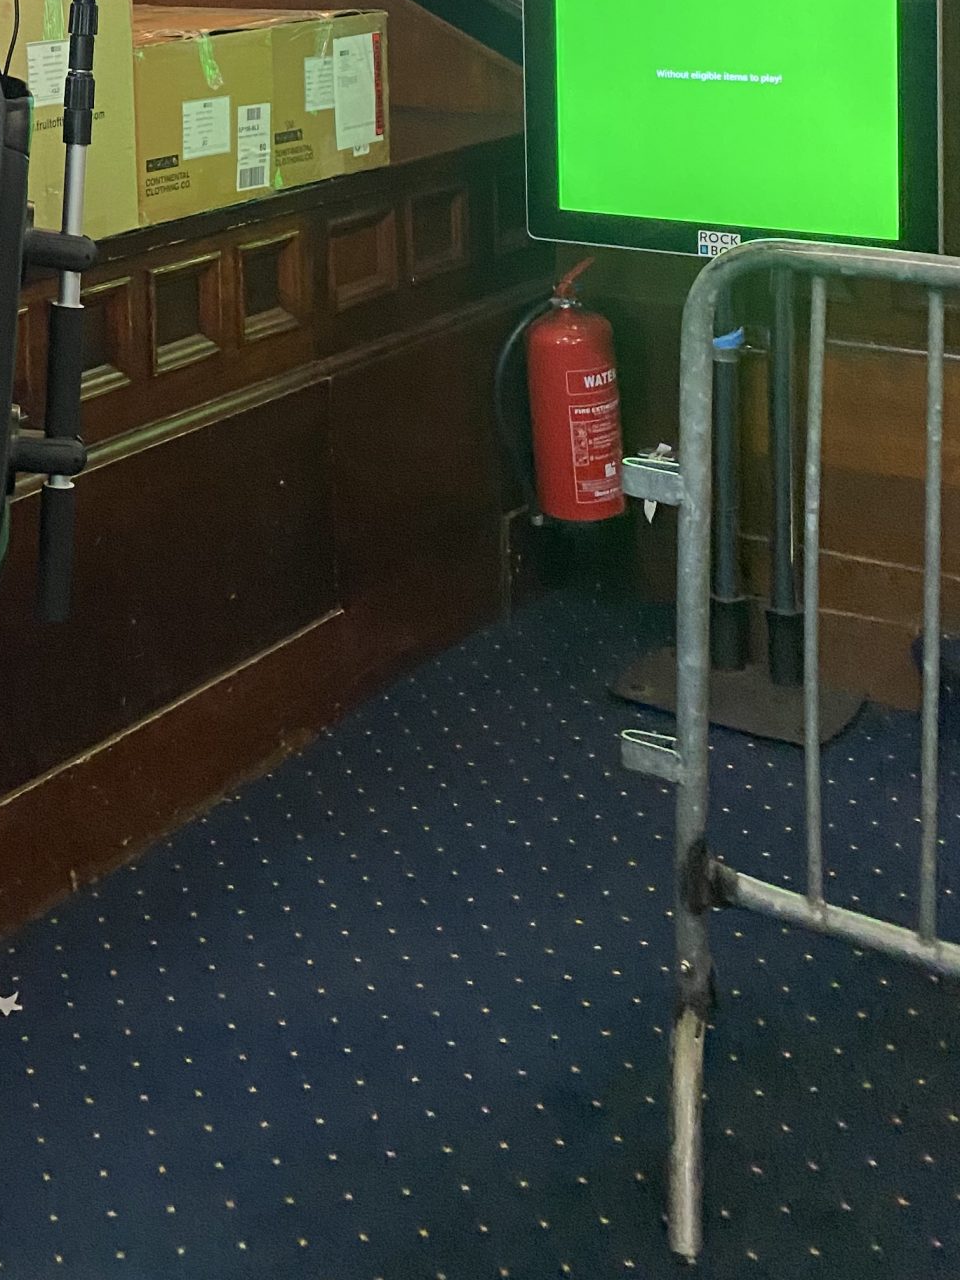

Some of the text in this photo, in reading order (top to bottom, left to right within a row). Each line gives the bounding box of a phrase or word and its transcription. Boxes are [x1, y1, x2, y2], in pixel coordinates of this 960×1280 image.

[656, 69, 690, 80] Without
[690, 71, 722, 83] eligible
[723, 72, 749, 82] items
[749, 73, 760, 83] to
[145, 170, 190, 188] CONTINENTAL
[145, 182, 180, 197] CLOTHING
[699, 231, 738, 246] ROCK
